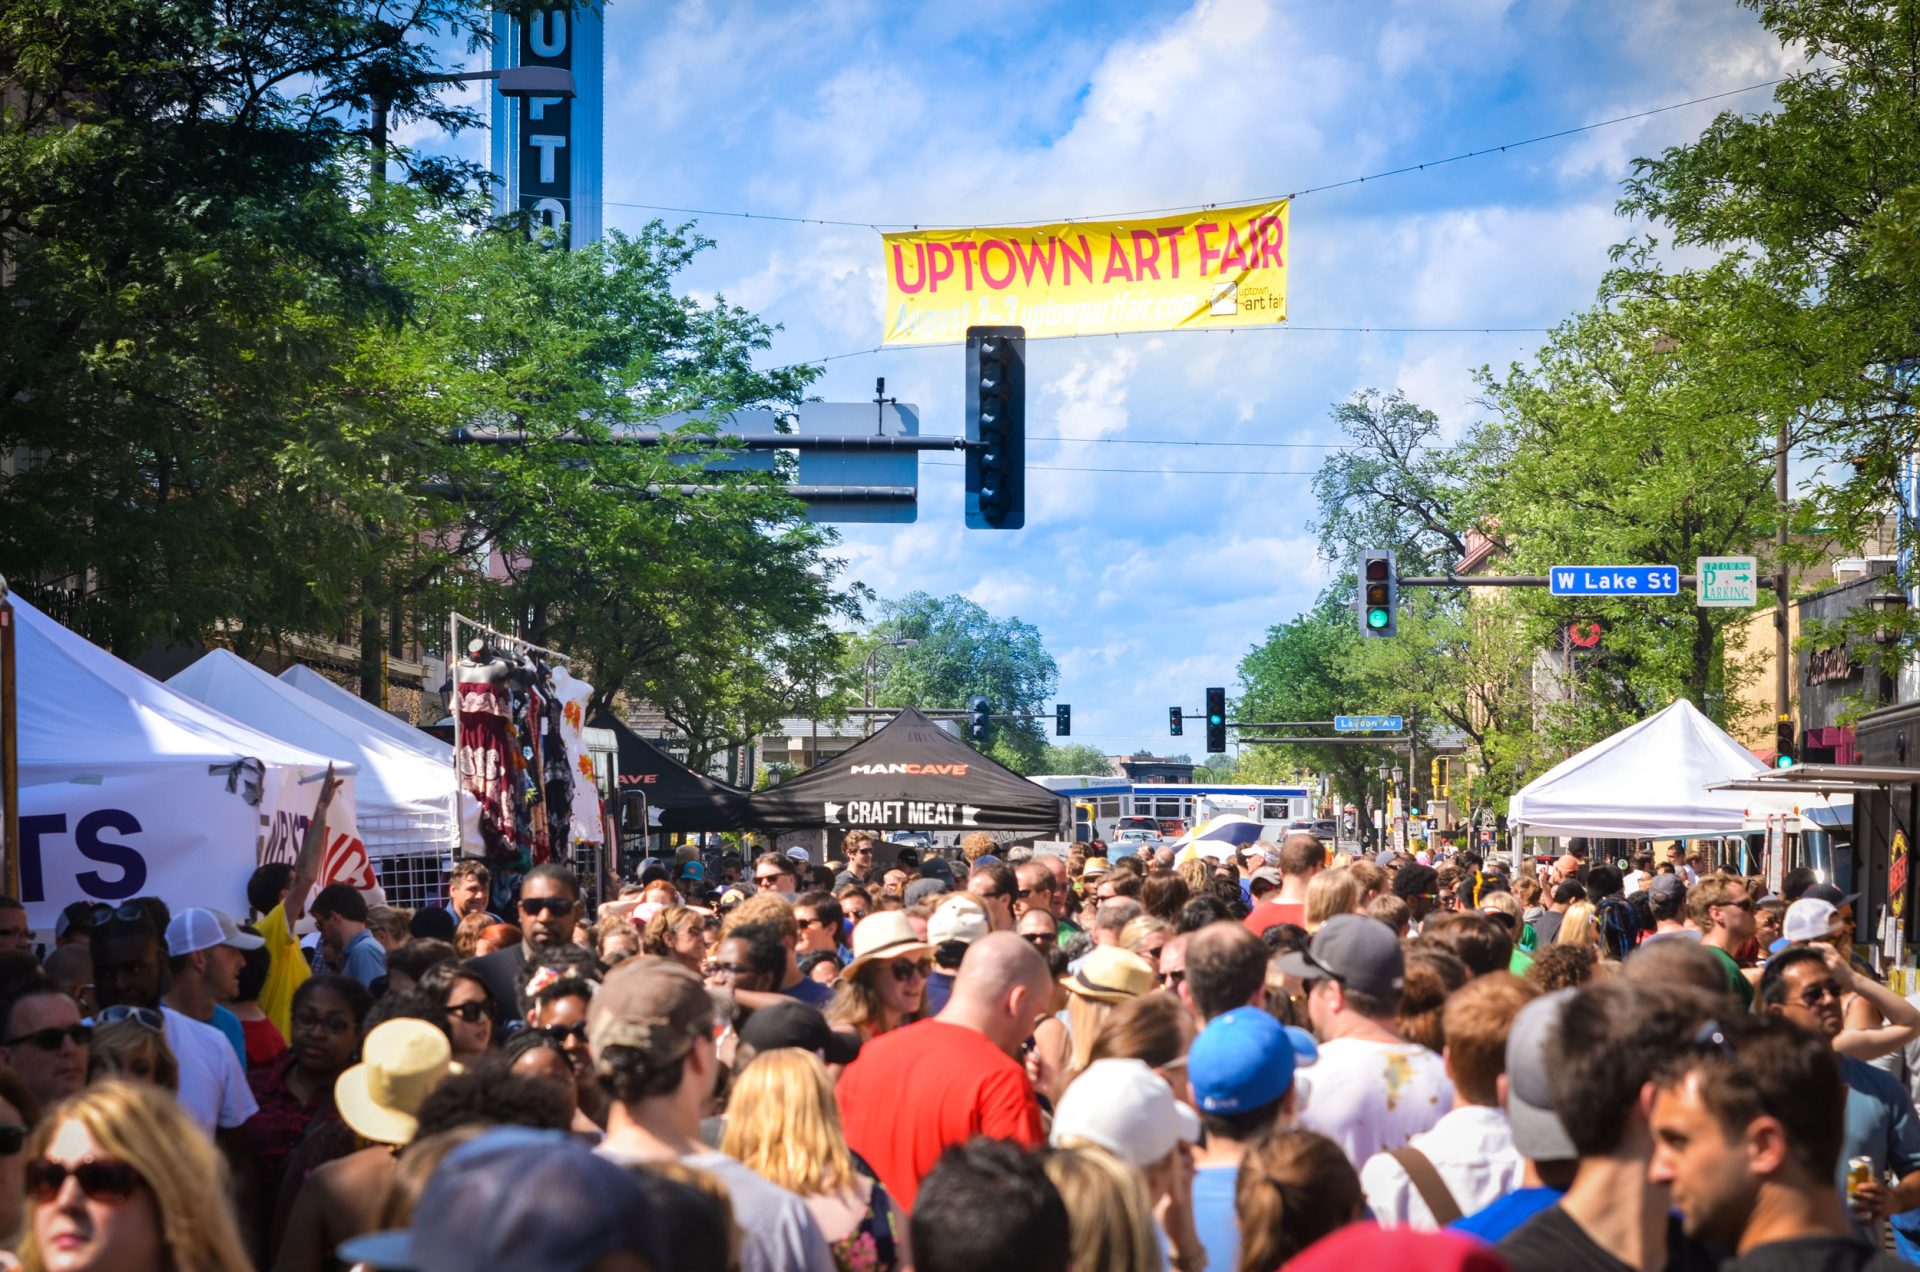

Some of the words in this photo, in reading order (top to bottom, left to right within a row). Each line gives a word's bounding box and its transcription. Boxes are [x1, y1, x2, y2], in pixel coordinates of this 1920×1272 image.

[892, 232, 1093, 294] UPTOWN
[1102, 225, 1186, 284] ART
[1194, 214, 1285, 277] FAIR
[1239, 286, 1269, 298] uptown
[1245, 296, 1267, 311] art
[1269, 294, 1284, 309] fair
[1557, 572, 1575, 589] W
[1585, 572, 1638, 590] Lake
[1647, 572, 1672, 589] St
[1383, 719, 1396, 728] Av
[850, 763, 967, 776] MANCAVE
[847, 801, 905, 825] CRAFT
[908, 801, 957, 826] MEAT
